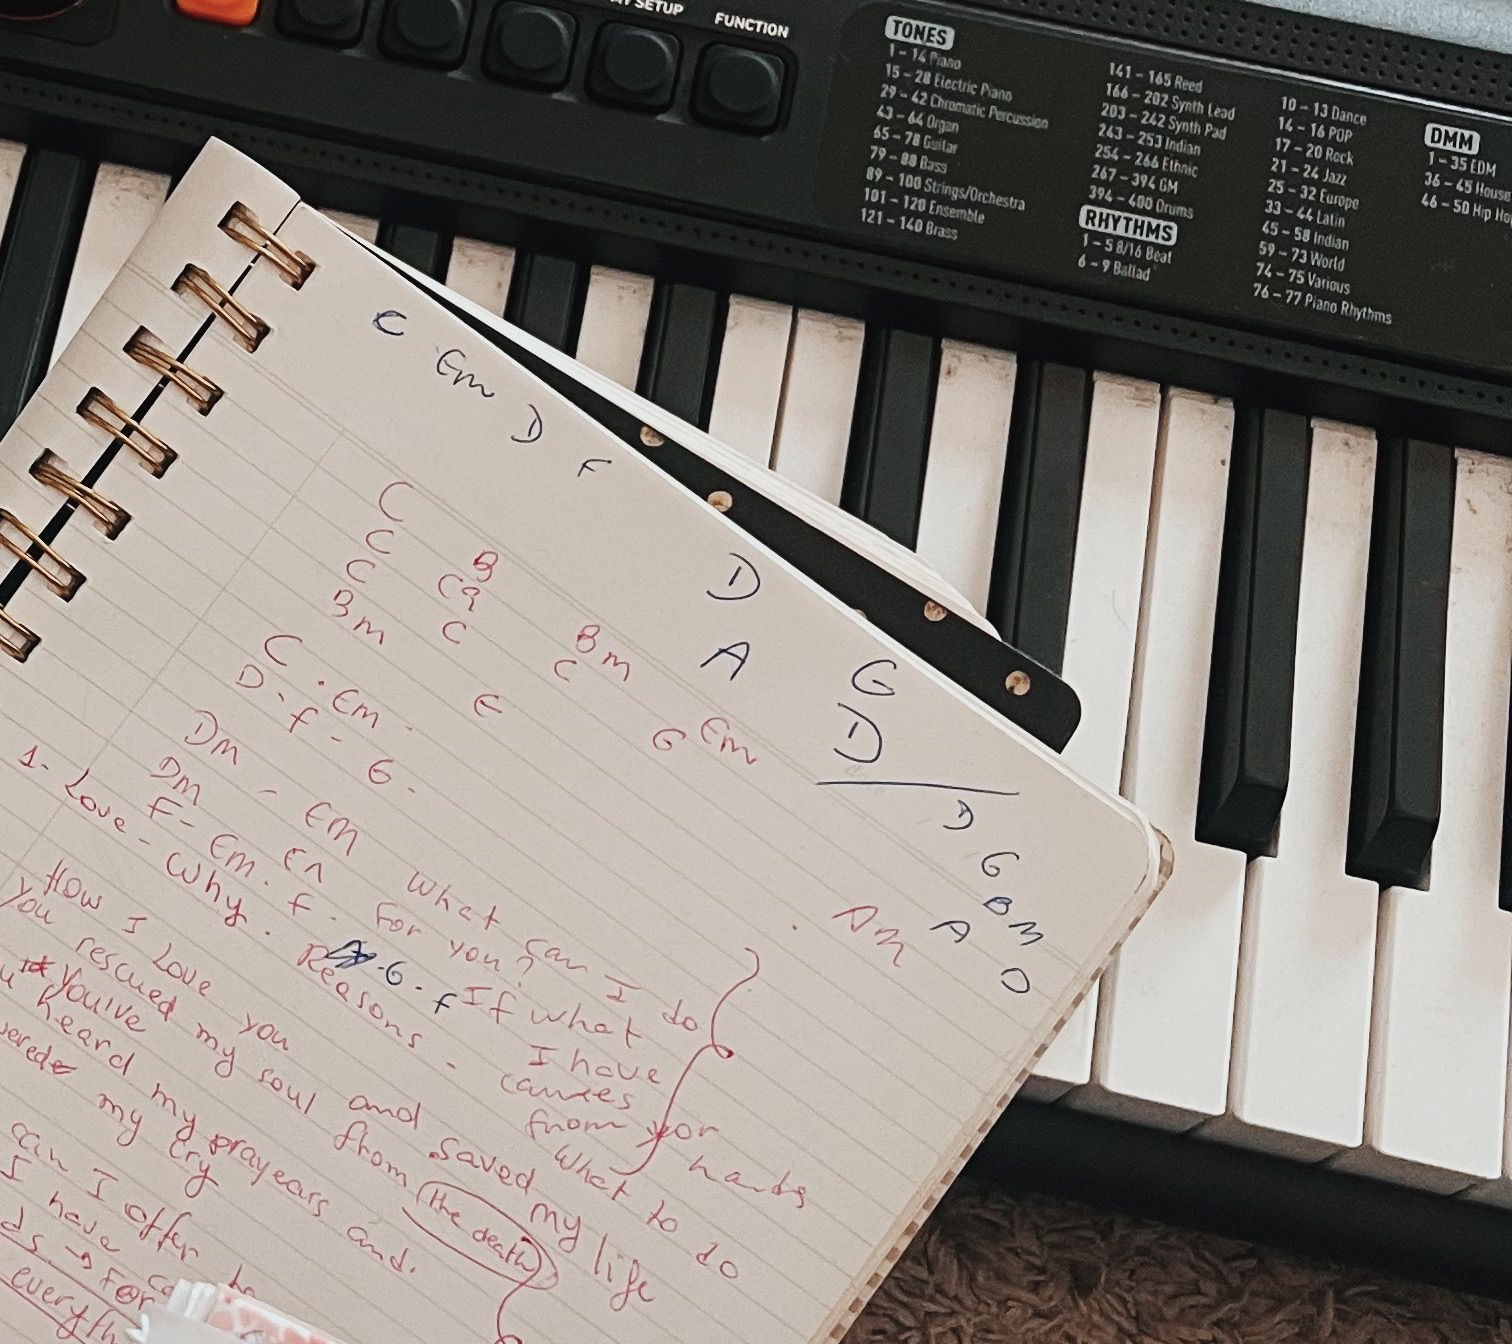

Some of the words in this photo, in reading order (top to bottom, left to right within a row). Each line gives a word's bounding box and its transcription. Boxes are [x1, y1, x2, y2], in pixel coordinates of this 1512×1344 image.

[714, 11, 790, 39] FUNCTION
[891, 19, 947, 45] TONES
[933, 73, 978, 96] Electric
[979, 83, 1013, 102] Piano
[1109, 62, 1132, 79] 141
[1149, 70, 1172, 87] 165
[1174, 74, 1203, 94] Reed
[929, 93, 986, 117] Chromatic
[988, 106, 1049, 129] Percussion
[1171, 95, 1204, 115] Synth
[1207, 103, 1236, 121] Lead
[1332, 106, 1367, 126] Dance
[1140, 111, 1165, 128] 242
[1168, 115, 1201, 135] Synth
[1204, 123, 1227, 141] Pad
[1310, 122, 1325, 138] 16
[1329, 126, 1353, 144] POP
[1430, 127, 1474, 152] DMM
[1138, 132, 1162, 149] 253
[1164, 136, 1201, 156] Indian
[1275, 137, 1291, 152] 17
[1325, 146, 1354, 166] Rock
[1091, 164, 1117, 182] 267
[1159, 176, 1178, 194] GM
[1270, 157, 1287, 173] 21
[1322, 168, 1348, 187] Jazz
[863, 187, 886, 204] 101
[928, 200, 986, 225] Ensemble
[924, 178, 1026, 212] Strings/Orchestra
[1085, 211, 1174, 242] RHYTHMS
[1472, 202, 1492, 222] Hip
[1145, 246, 1172, 264] Beat
[1258, 240, 1276, 257] 59
[1291, 247, 1308, 264] 73
[1310, 251, 1345, 272] World
[1113, 261, 1151, 282] Ballad
[1253, 283, 1270, 299] 76
[1286, 290, 1302, 306] 77
[1304, 294, 1337, 315] Piano
[1340, 300, 1393, 326] Rhythms
